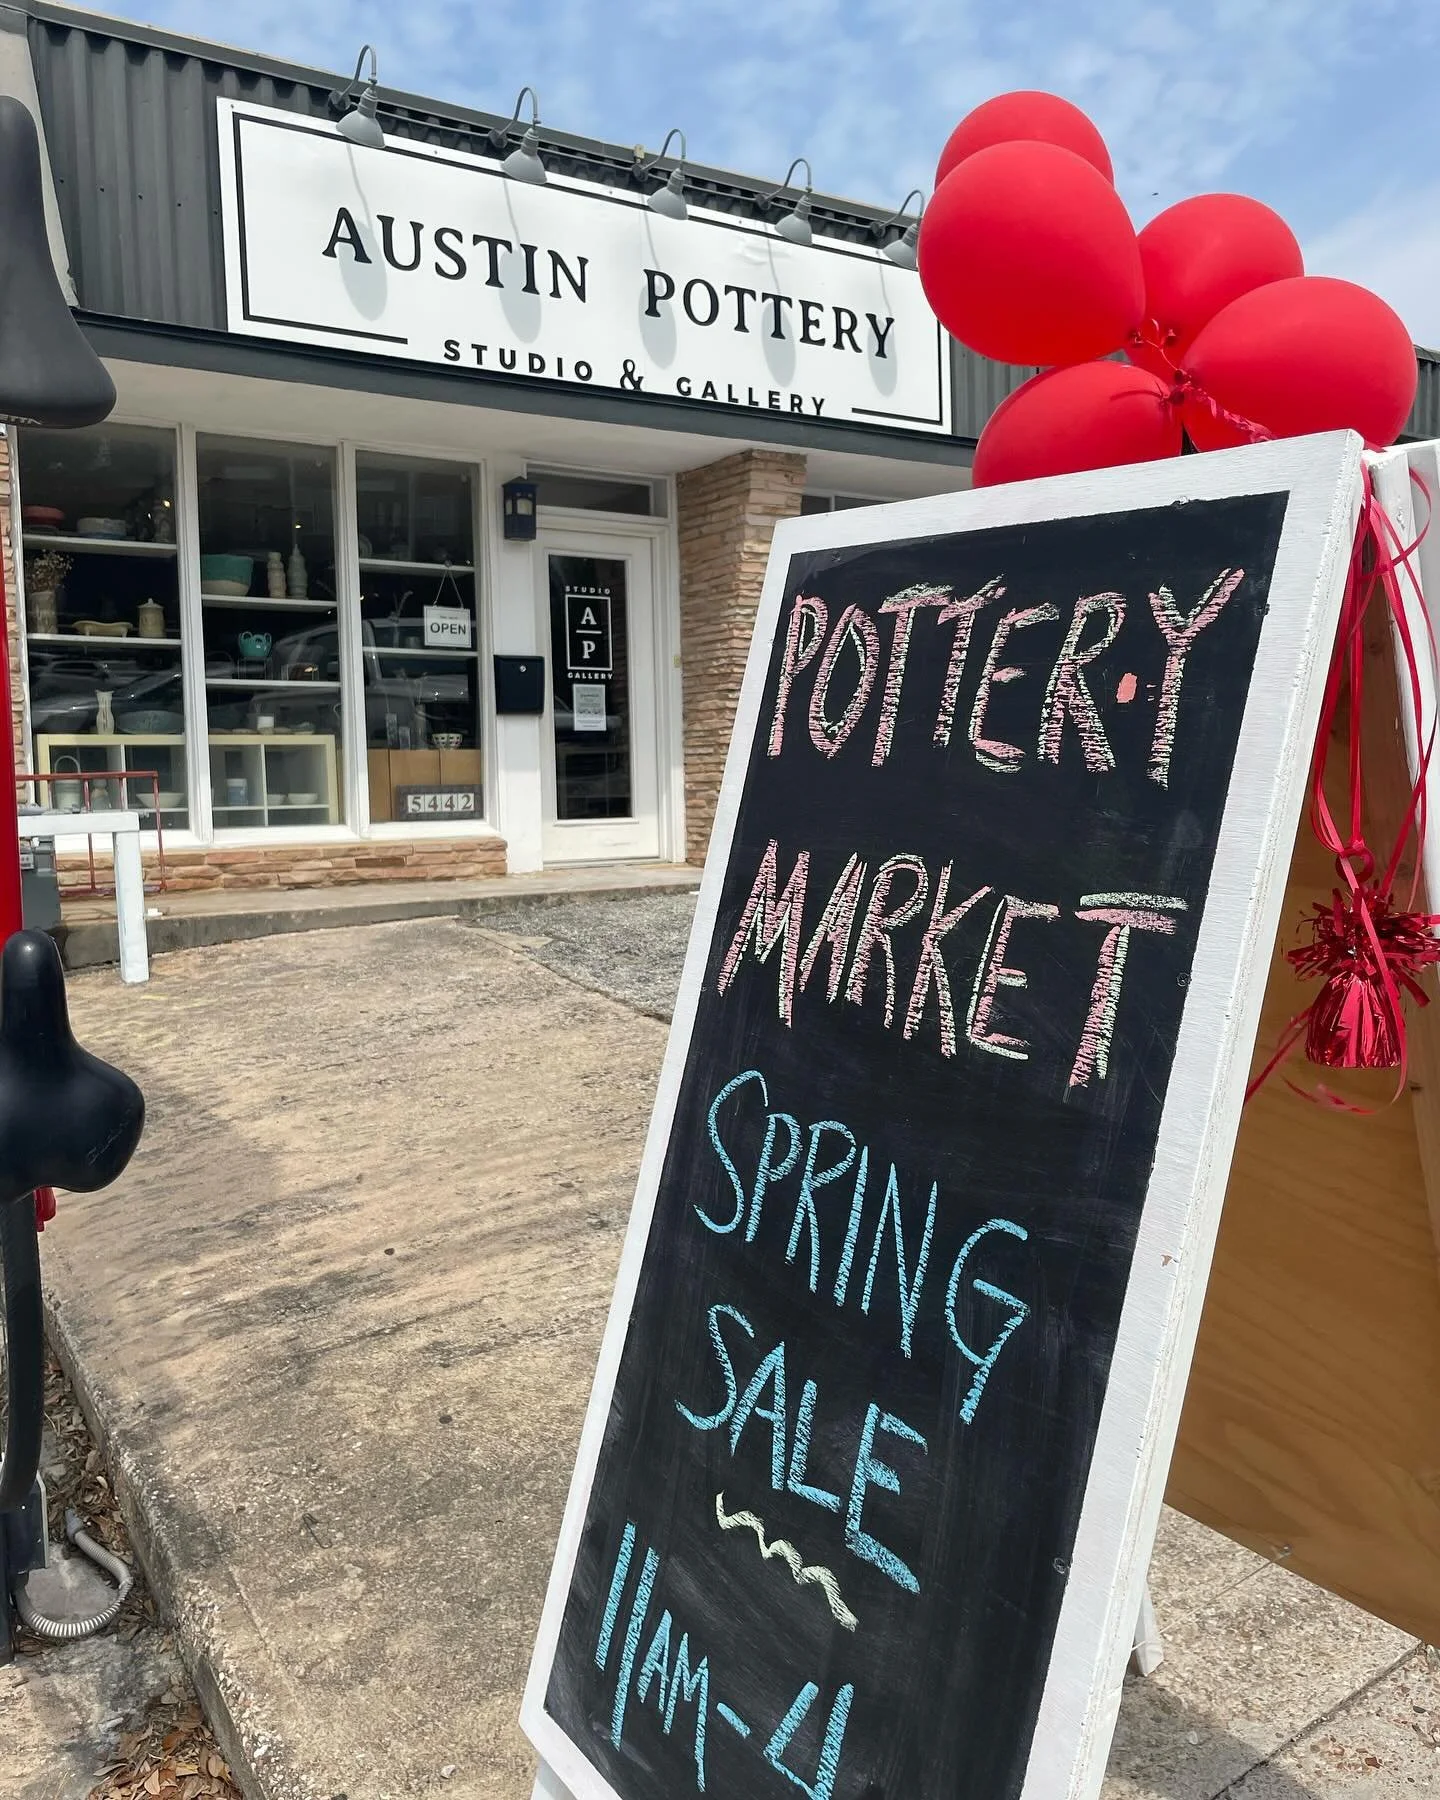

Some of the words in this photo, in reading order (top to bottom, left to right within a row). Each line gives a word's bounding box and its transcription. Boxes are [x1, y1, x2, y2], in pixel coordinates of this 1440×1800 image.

[322, 207, 589, 303] AUSTIN
[643, 268, 895, 359] POTTERY
[443, 339, 593, 381] STUDIO
[619, 358, 645, 391] &
[676, 376, 826, 415] GALLERY
[565, 585, 611, 595] STUDIO
[430, 622, 466, 635] OPEN
[580, 606, 597, 625] A
[582, 640, 596, 659] P
[567, 671, 613, 680] GALLERY
[766, 568, 1245, 790] POTTERY
[411, 794, 473, 812] 5442
[717, 838, 1188, 1088] MARKET
[694, 1070, 1031, 1426] SPRING
[676, 1304, 928, 1594] SALE
